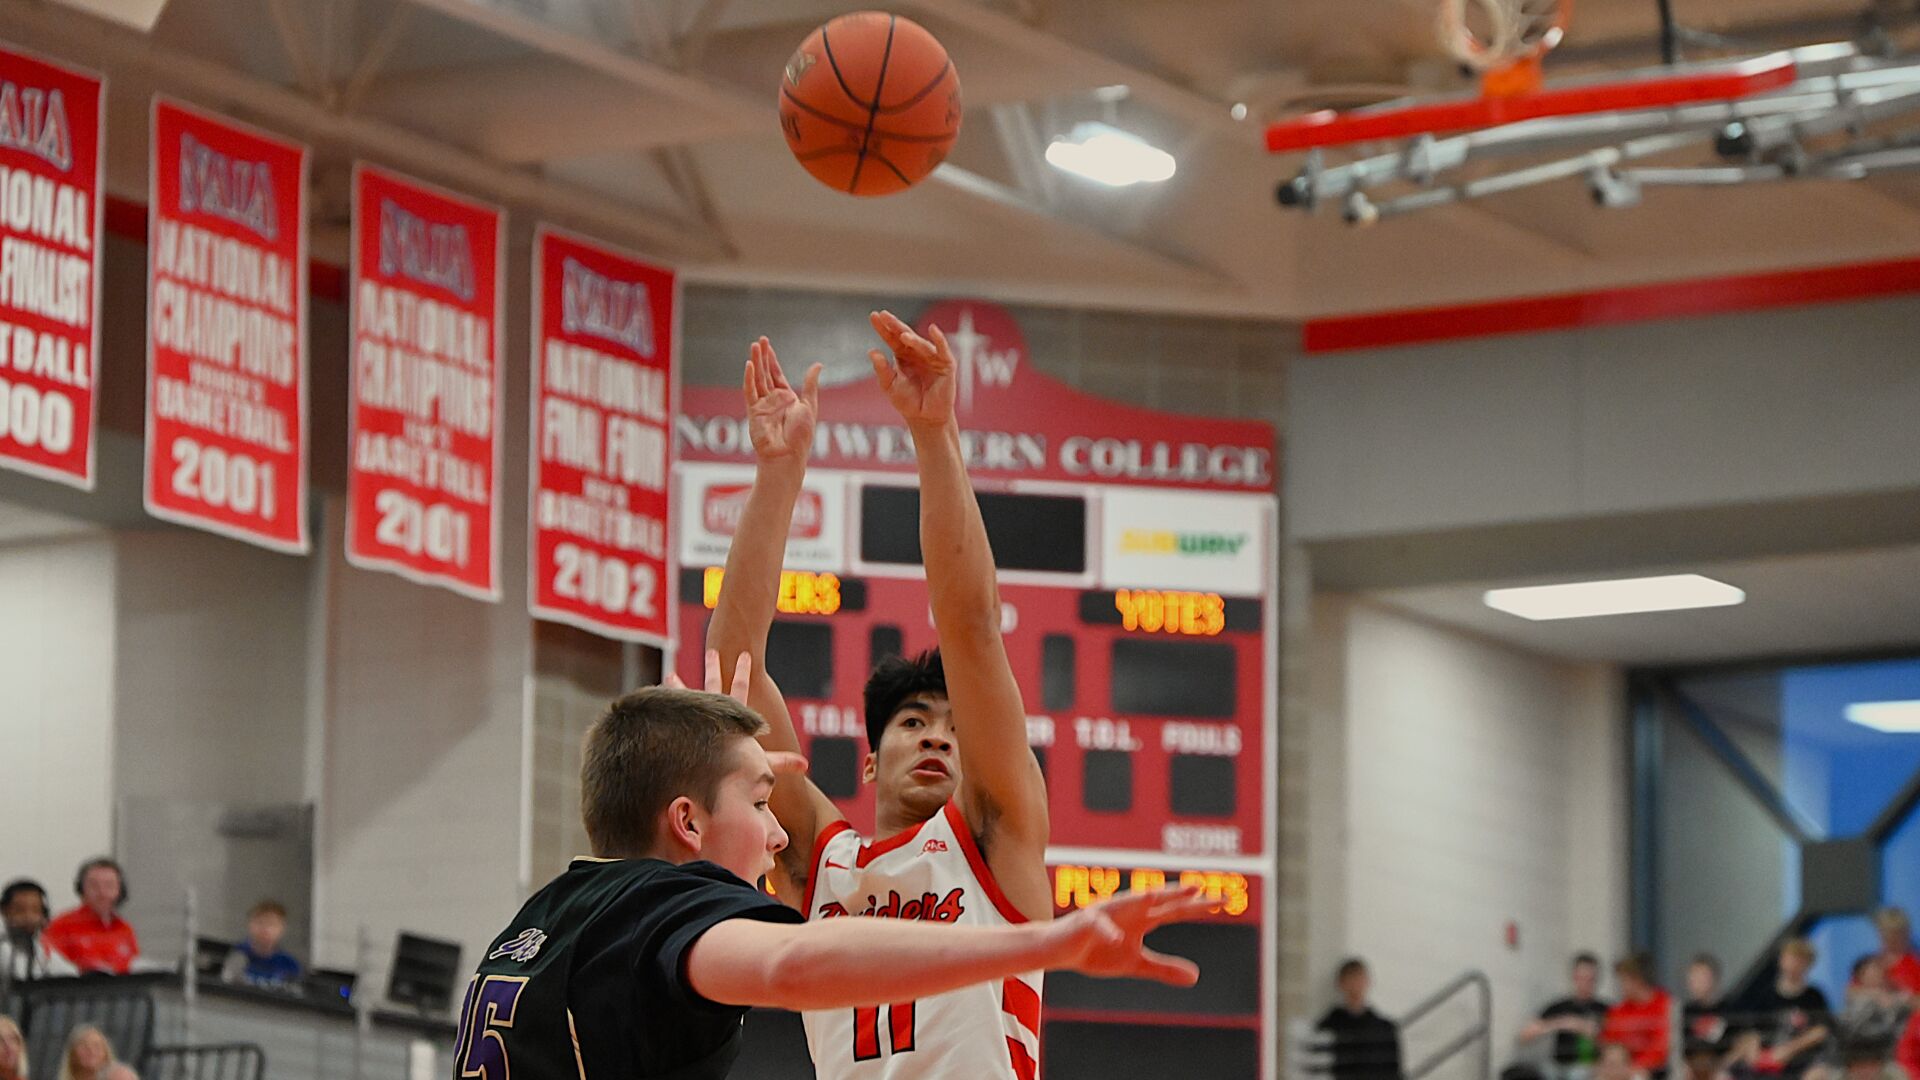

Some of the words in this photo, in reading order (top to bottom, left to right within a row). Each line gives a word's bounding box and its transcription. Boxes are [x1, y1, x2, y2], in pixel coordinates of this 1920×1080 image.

[157, 220, 292, 315] NATIONAL
[157, 279, 294, 386] CHAMPIONS
[359, 279, 490, 370] NATIONAL
[156, 374, 290, 453] BASKETBALL
[545, 337, 666, 422] NATIONAL
[172, 437, 275, 520] 2001
[1060, 436, 1272, 486] COLLEGE
[540, 488, 664, 560] BASKETBALL
[1121, 530, 1247, 557] SUBWAY
[1161, 720, 1242, 756] FOULS
